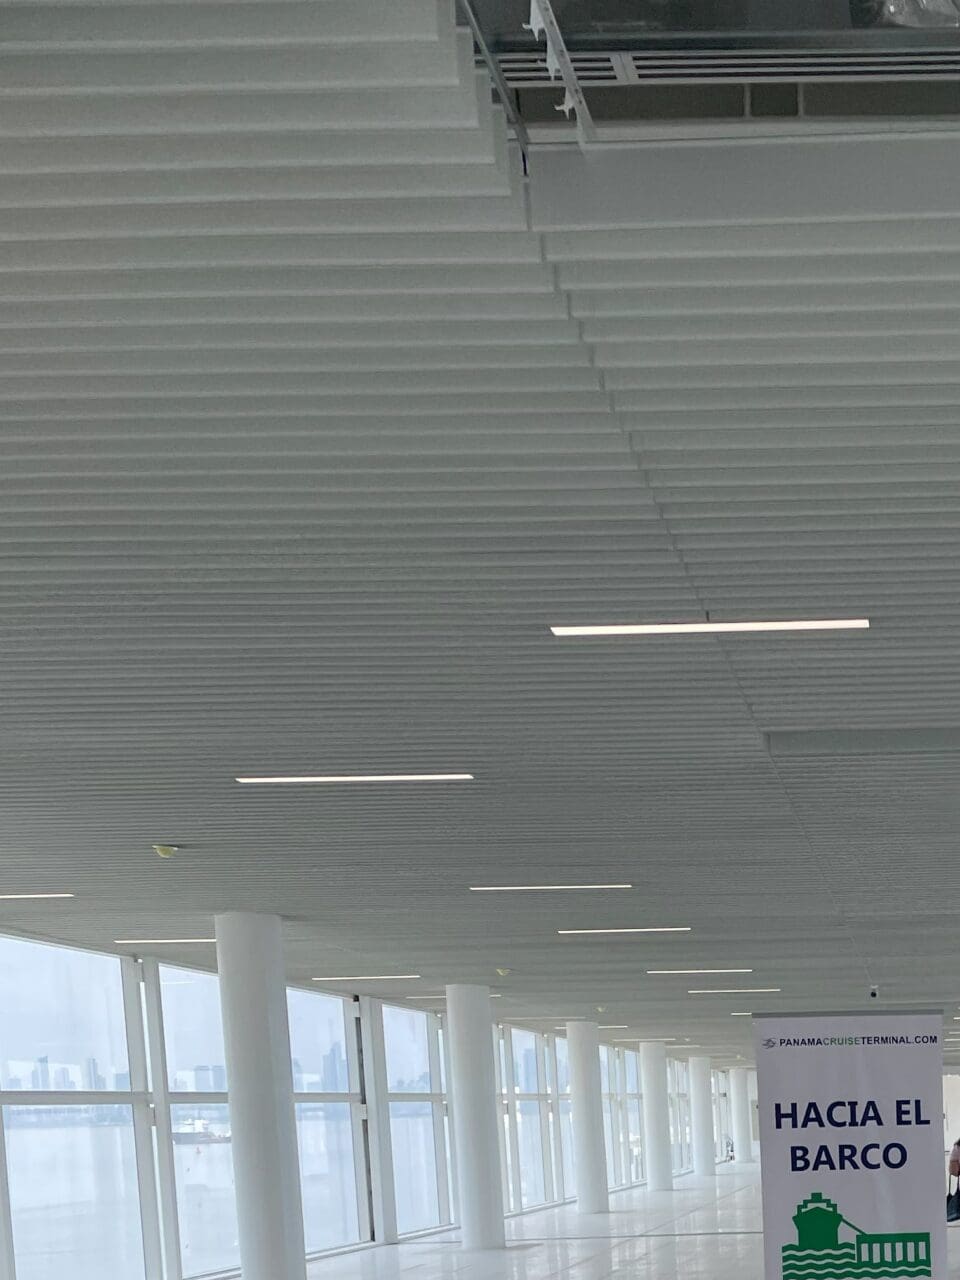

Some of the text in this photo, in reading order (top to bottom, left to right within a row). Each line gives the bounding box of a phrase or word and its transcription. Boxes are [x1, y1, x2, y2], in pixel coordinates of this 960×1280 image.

[779, 1035, 938, 1047] PANAMACRUISETERMINAL.COM
[774, 1099, 931, 1129] HACIA EL
[790, 1142, 908, 1172] BARCO
